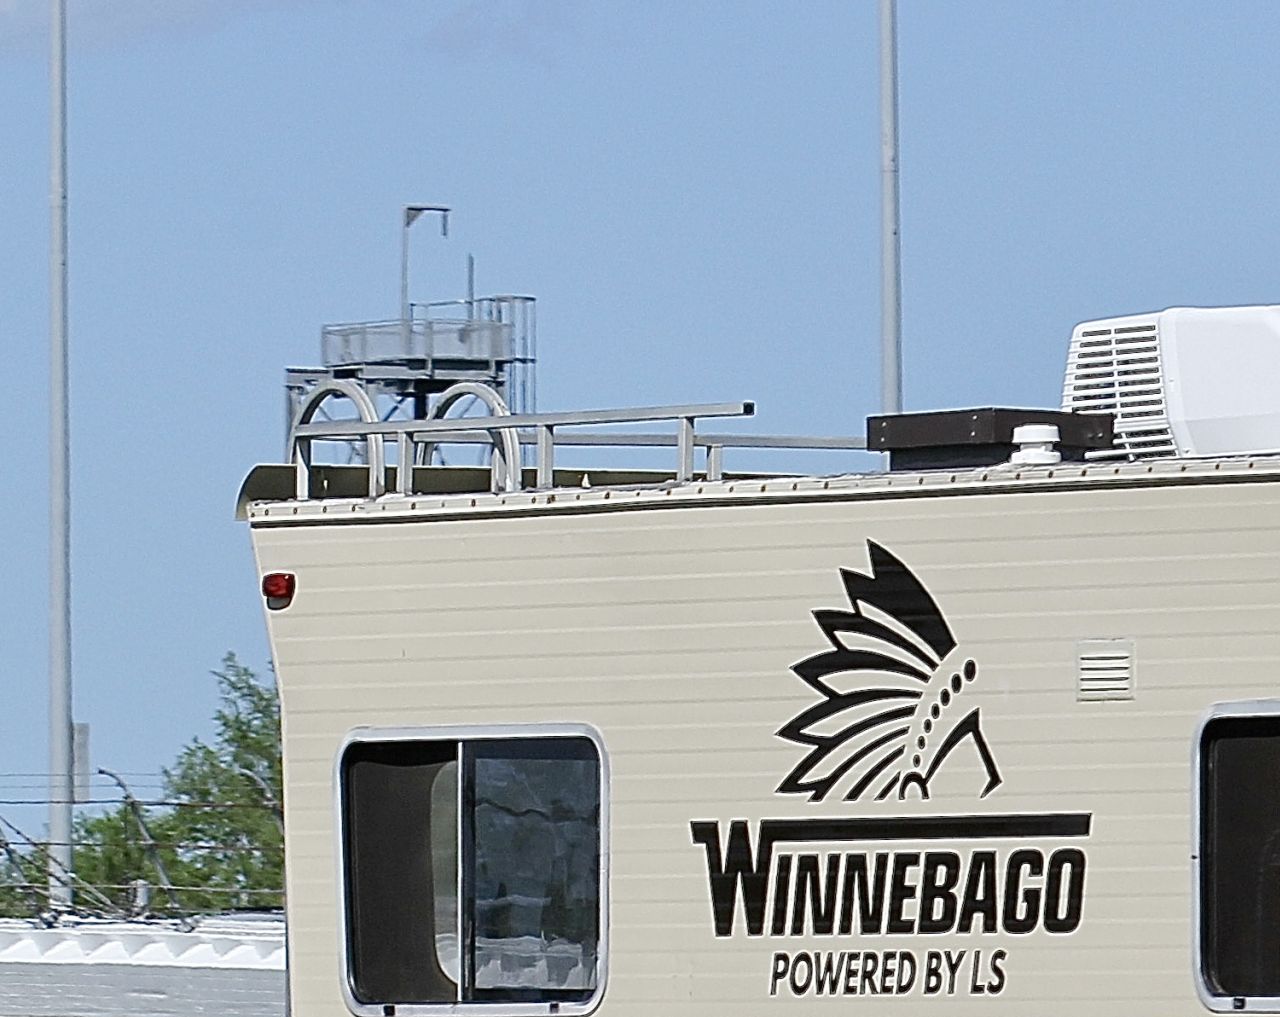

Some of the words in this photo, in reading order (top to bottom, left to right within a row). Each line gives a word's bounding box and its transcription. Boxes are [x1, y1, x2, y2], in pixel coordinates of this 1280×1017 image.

[690, 814, 1091, 937] WINNEBAGO
[770, 950, 917, 995] POWERED
[923, 950, 965, 994] BY
[969, 949, 1006, 994] LS
